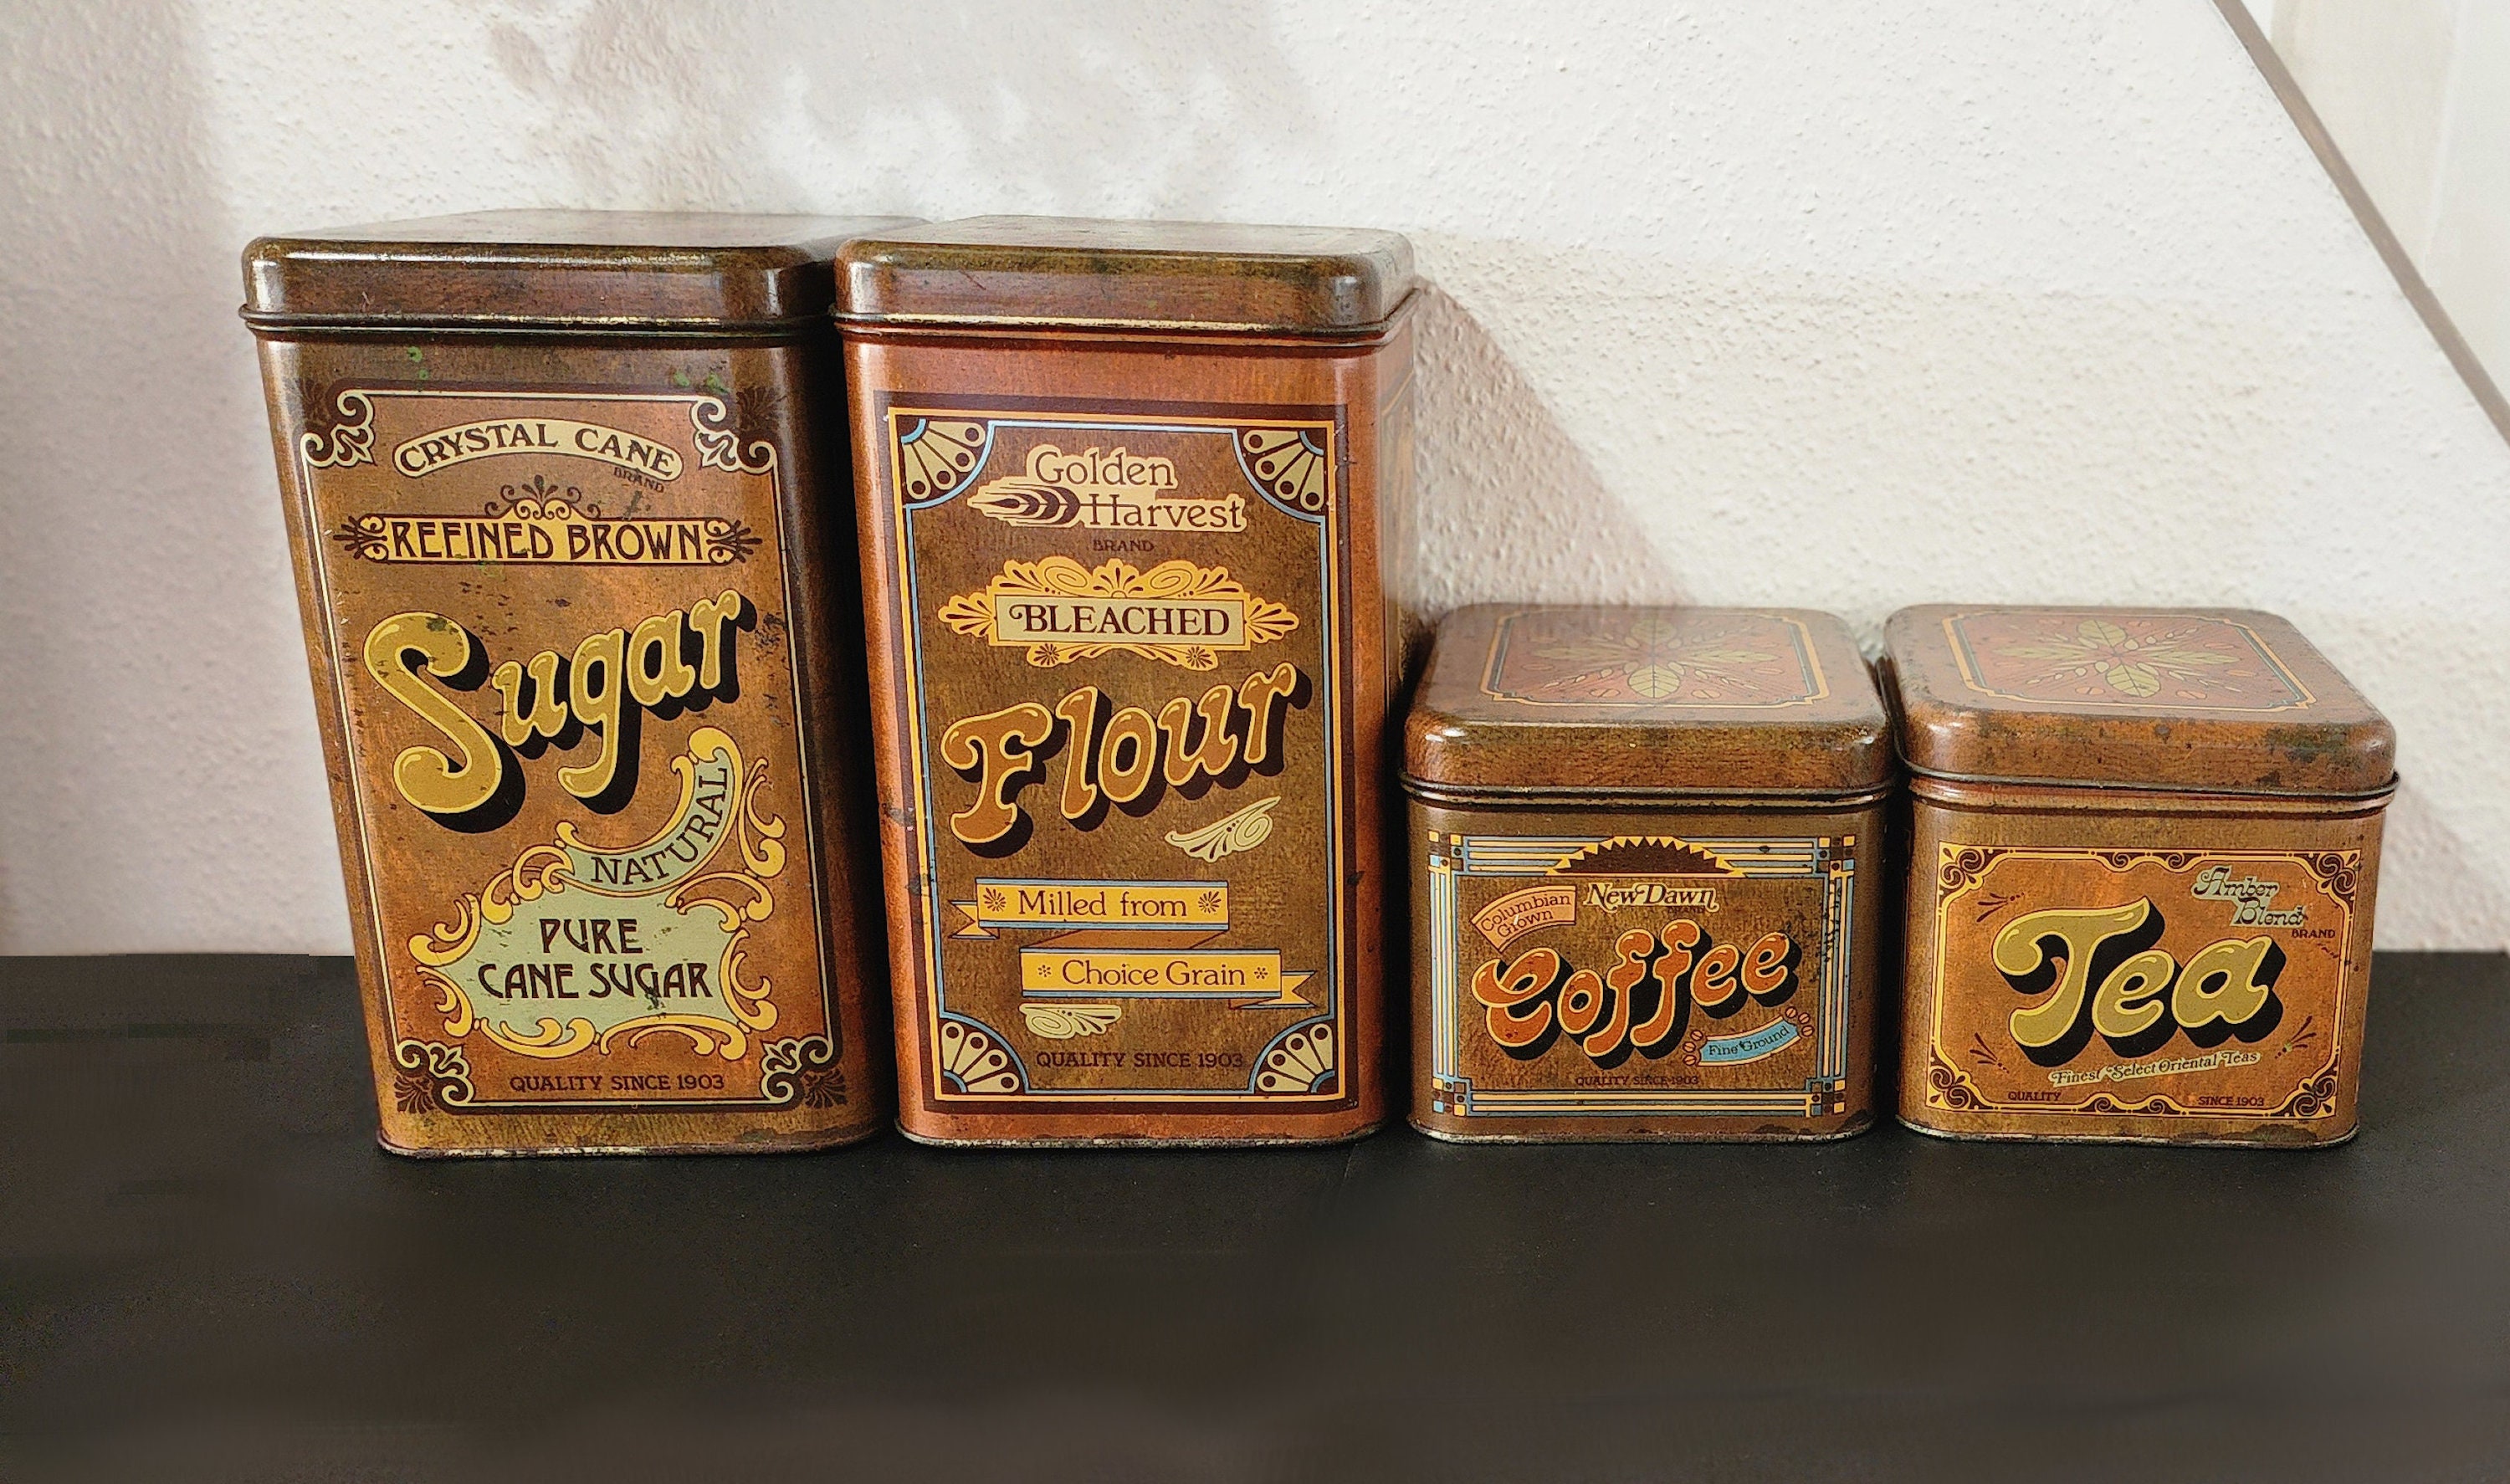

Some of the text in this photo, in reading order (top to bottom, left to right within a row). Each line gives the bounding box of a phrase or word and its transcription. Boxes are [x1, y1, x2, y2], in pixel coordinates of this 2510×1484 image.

[400, 422, 675, 477] CRYSTAL CANE
[613, 466, 666, 494] BRAND
[1034, 450, 1176, 488] Golden
[1088, 492, 1244, 530] Harvest
[392, 522, 704, 561] REFINED BROWN
[1092, 538, 1155, 554] BRAND
[1009, 602, 1230, 637] BLEACHED
[363, 588, 750, 820] Sugar
[940, 662, 1304, 848] Flour
[590, 766, 728, 887] NATURAL
[1585, 883, 1718, 913] New Dawn
[2193, 867, 2279, 898] Amber
[1017, 889, 1188, 918] Milled from
[1480, 893, 1572, 933] Columbian
[2234, 897, 2308, 926] Blend
[540, 919, 643, 954] PURE
[1497, 909, 1555, 938] Grown
[2291, 929, 2336, 939] BRAND
[477, 963, 715, 1000] CANE SUGAR
[1061, 959, 1246, 986] Choice Grain
[1991, 896, 2279, 1056] Tea
[1470, 919, 1795, 1062] Coffee
[1708, 1026, 1791, 1057] Fine Ground
[1036, 1052, 1245, 1069] QUALITY SINCE 1903
[2052, 1051, 2258, 1086] Finest Select Oriental Teas
[509, 1074, 725, 1093] QUALITY SINCE 1903
[1575, 1075, 1699, 1087] QUALITY SINCE 1903
[2008, 1091, 2062, 1103] QUALITY
[2197, 1095, 2265, 1107] SINCE 1903
